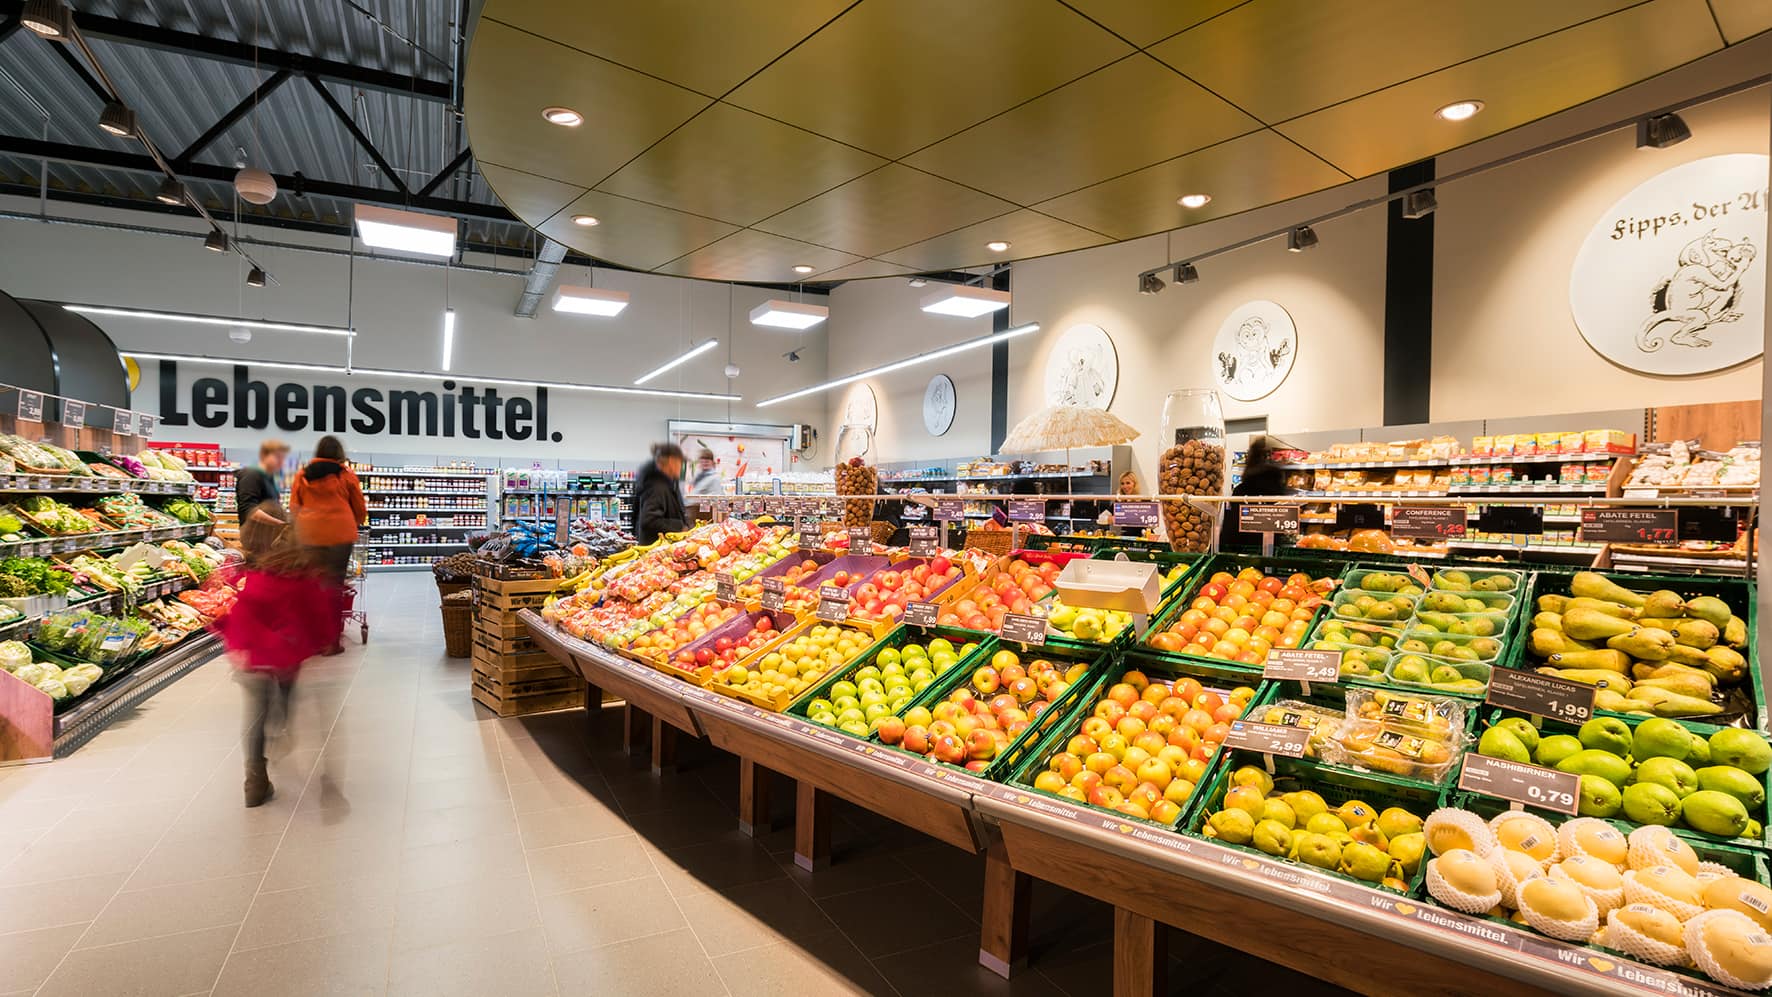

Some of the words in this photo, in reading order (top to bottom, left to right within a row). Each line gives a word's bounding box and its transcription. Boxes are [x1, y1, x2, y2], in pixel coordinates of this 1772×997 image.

[1611, 212, 1688, 240] Fipps,
[1692, 201, 1732, 221] der
[159, 359, 562, 443] Lebensmittel.
[1274, 520, 1298, 531] 1,99
[1435, 524, 1465, 535] 1,29
[1307, 666, 1336, 677] 2,49
[1508, 673, 1550, 687] ALEXANDER
[1551, 682, 1577, 693] LUCAS
[1548, 700, 1589, 719] 1,99
[1269, 740, 1303, 752] 2,99
[1485, 759, 1557, 780] NASHIBIRNEN
[1527, 785, 1574, 806] 0,79
[1102, 820, 1118, 831] Wir
[1132, 828, 1192, 853] Lebensmittel.
[1222, 854, 1241, 866] Wir
[1260, 863, 1332, 893] Lebensmittel.
[1371, 896, 1394, 911] Wir
[1417, 909, 1509, 945] Lebensmittel.
[1558, 949, 1586, 966] Wir
